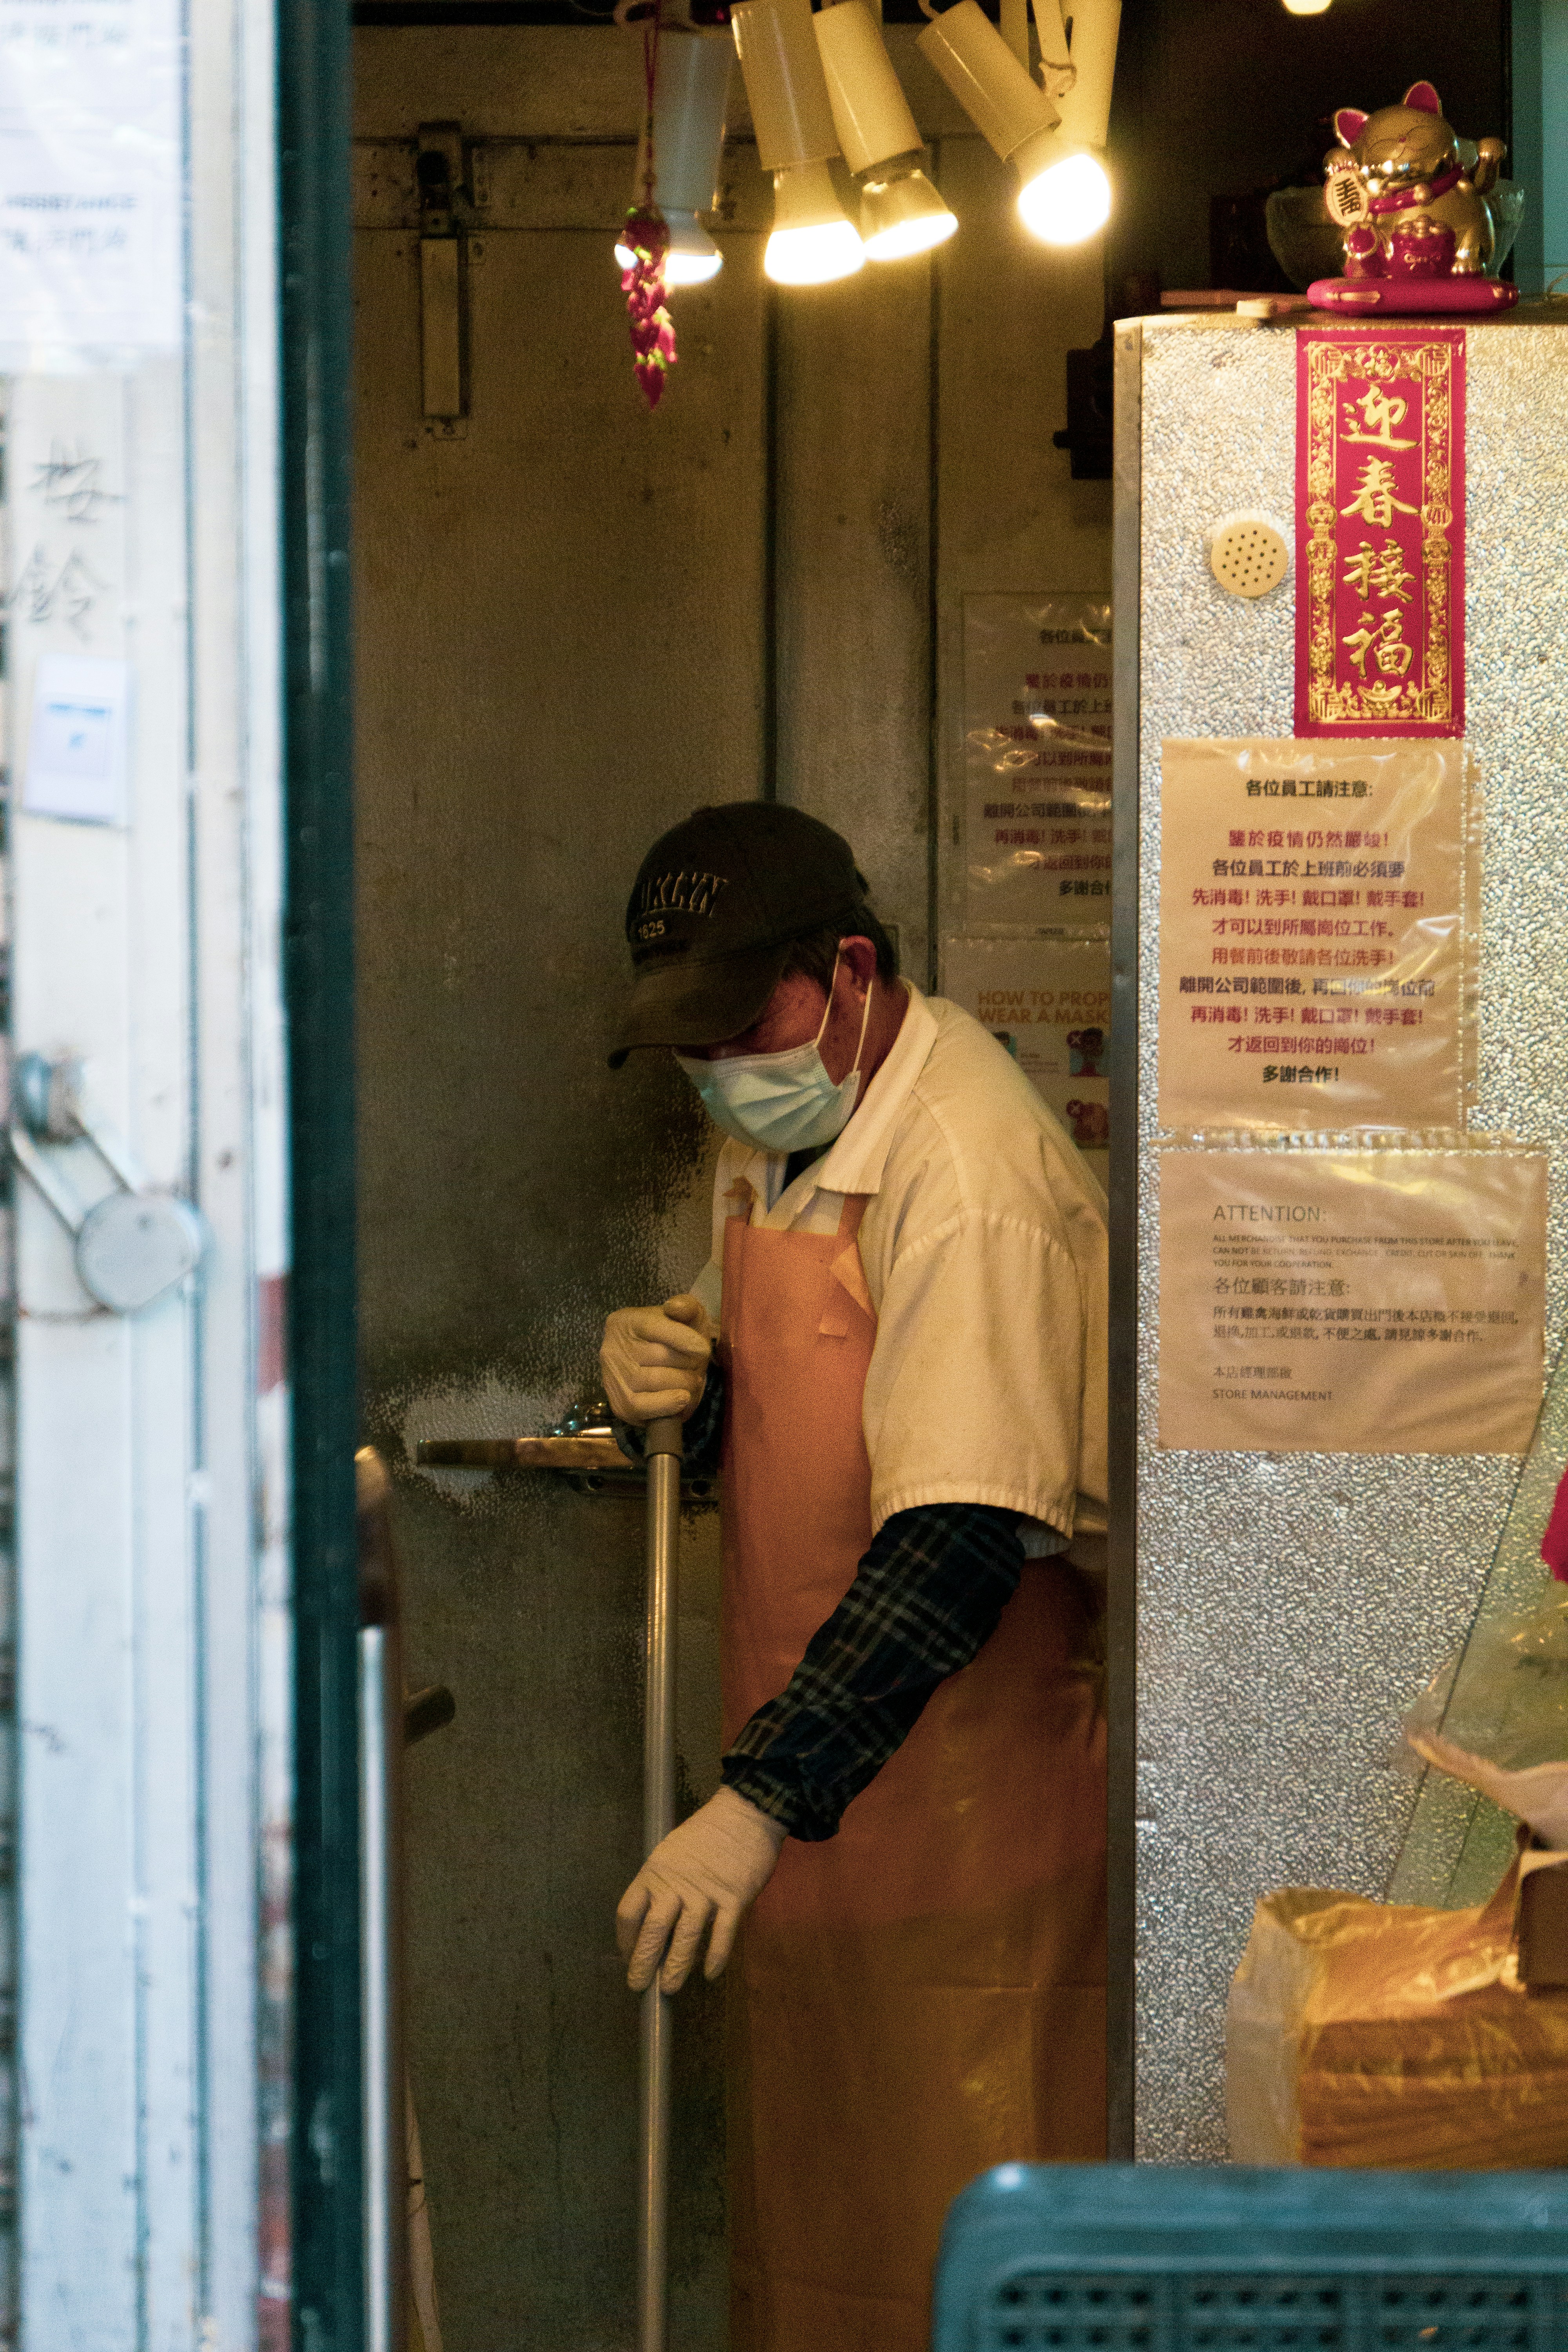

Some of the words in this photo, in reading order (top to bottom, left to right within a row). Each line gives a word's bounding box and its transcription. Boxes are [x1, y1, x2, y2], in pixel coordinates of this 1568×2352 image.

[1340, 384, 1421, 680] 迎春接福
[1246, 779, 1373, 798] 各位員工請注意:
[1192, 889, 1249, 906] 先消毒!
[1256, 889, 1296, 906] 洗手!
[1303, 889, 1360, 907] 戴口罩!
[1367, 890, 1424, 908] 戴手套!
[978, 991, 1024, 1005] HOW
[1029, 991, 1054, 1005] TO
[978, 1008, 1031, 1023] WEAR
[1036, 1009, 1049, 1023] A
[1055, 1009, 1109, 1024] MASK
[1191, 1006, 1248, 1023] 再消毒!
[1255, 1006, 1294, 1024] 洗手!
[1263, 1065, 1339, 1083] 多謝合作!
[1213, 1204, 1327, 1222] ATTENTION:
[1214, 1278, 1350, 1296] 各位顧客請注意:
[1212, 1389, 1246, 1399] STORE
[1251, 1390, 1333, 1401] MANAGEMENT
